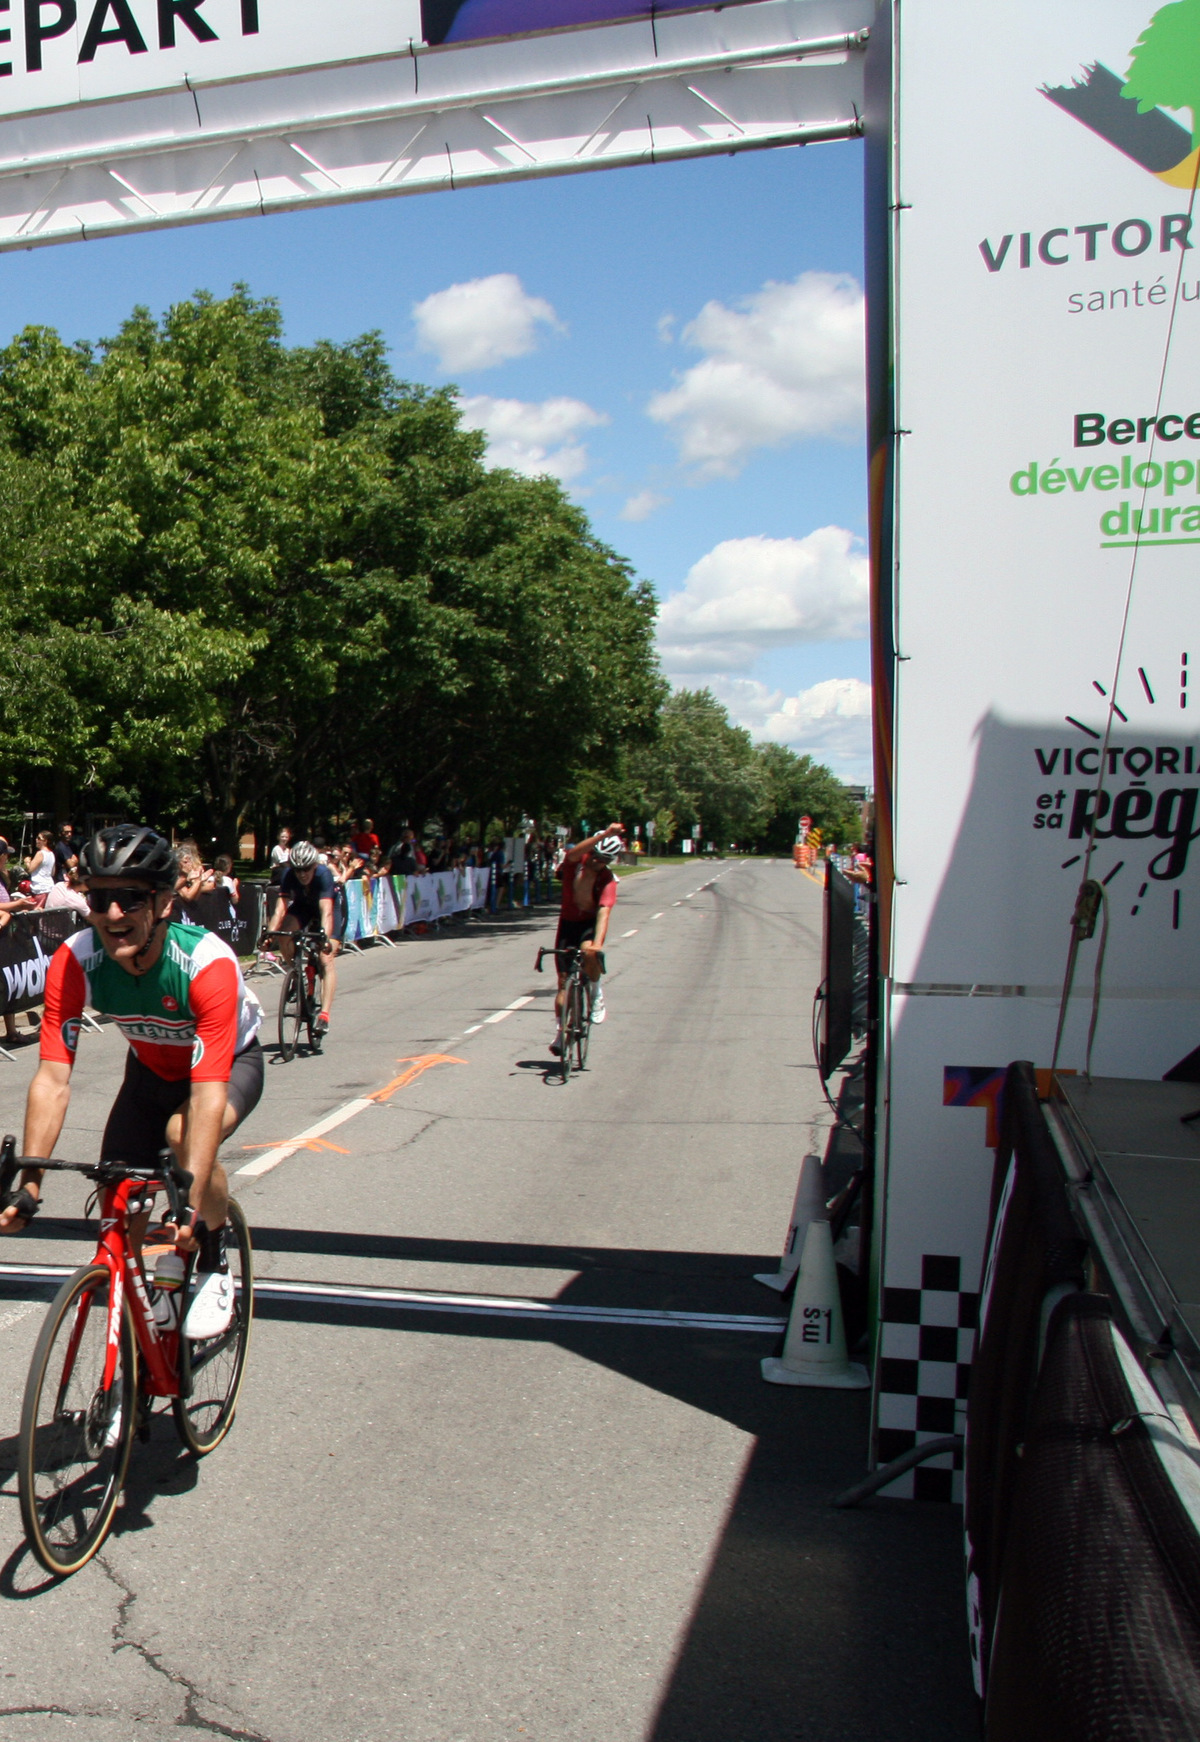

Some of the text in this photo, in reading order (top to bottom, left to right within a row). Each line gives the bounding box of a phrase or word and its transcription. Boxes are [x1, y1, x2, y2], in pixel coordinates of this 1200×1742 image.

[978, 214, 1194, 273] VICTOR
[1068, 276, 1166, 314] santé
[1009, 455, 1200, 496] dévelop
[1034, 746, 1200, 778] VICTORI
[1036, 789, 1066, 810] et
[1033, 811, 1063, 829] sa
[2, 936, 54, 1002] wah
